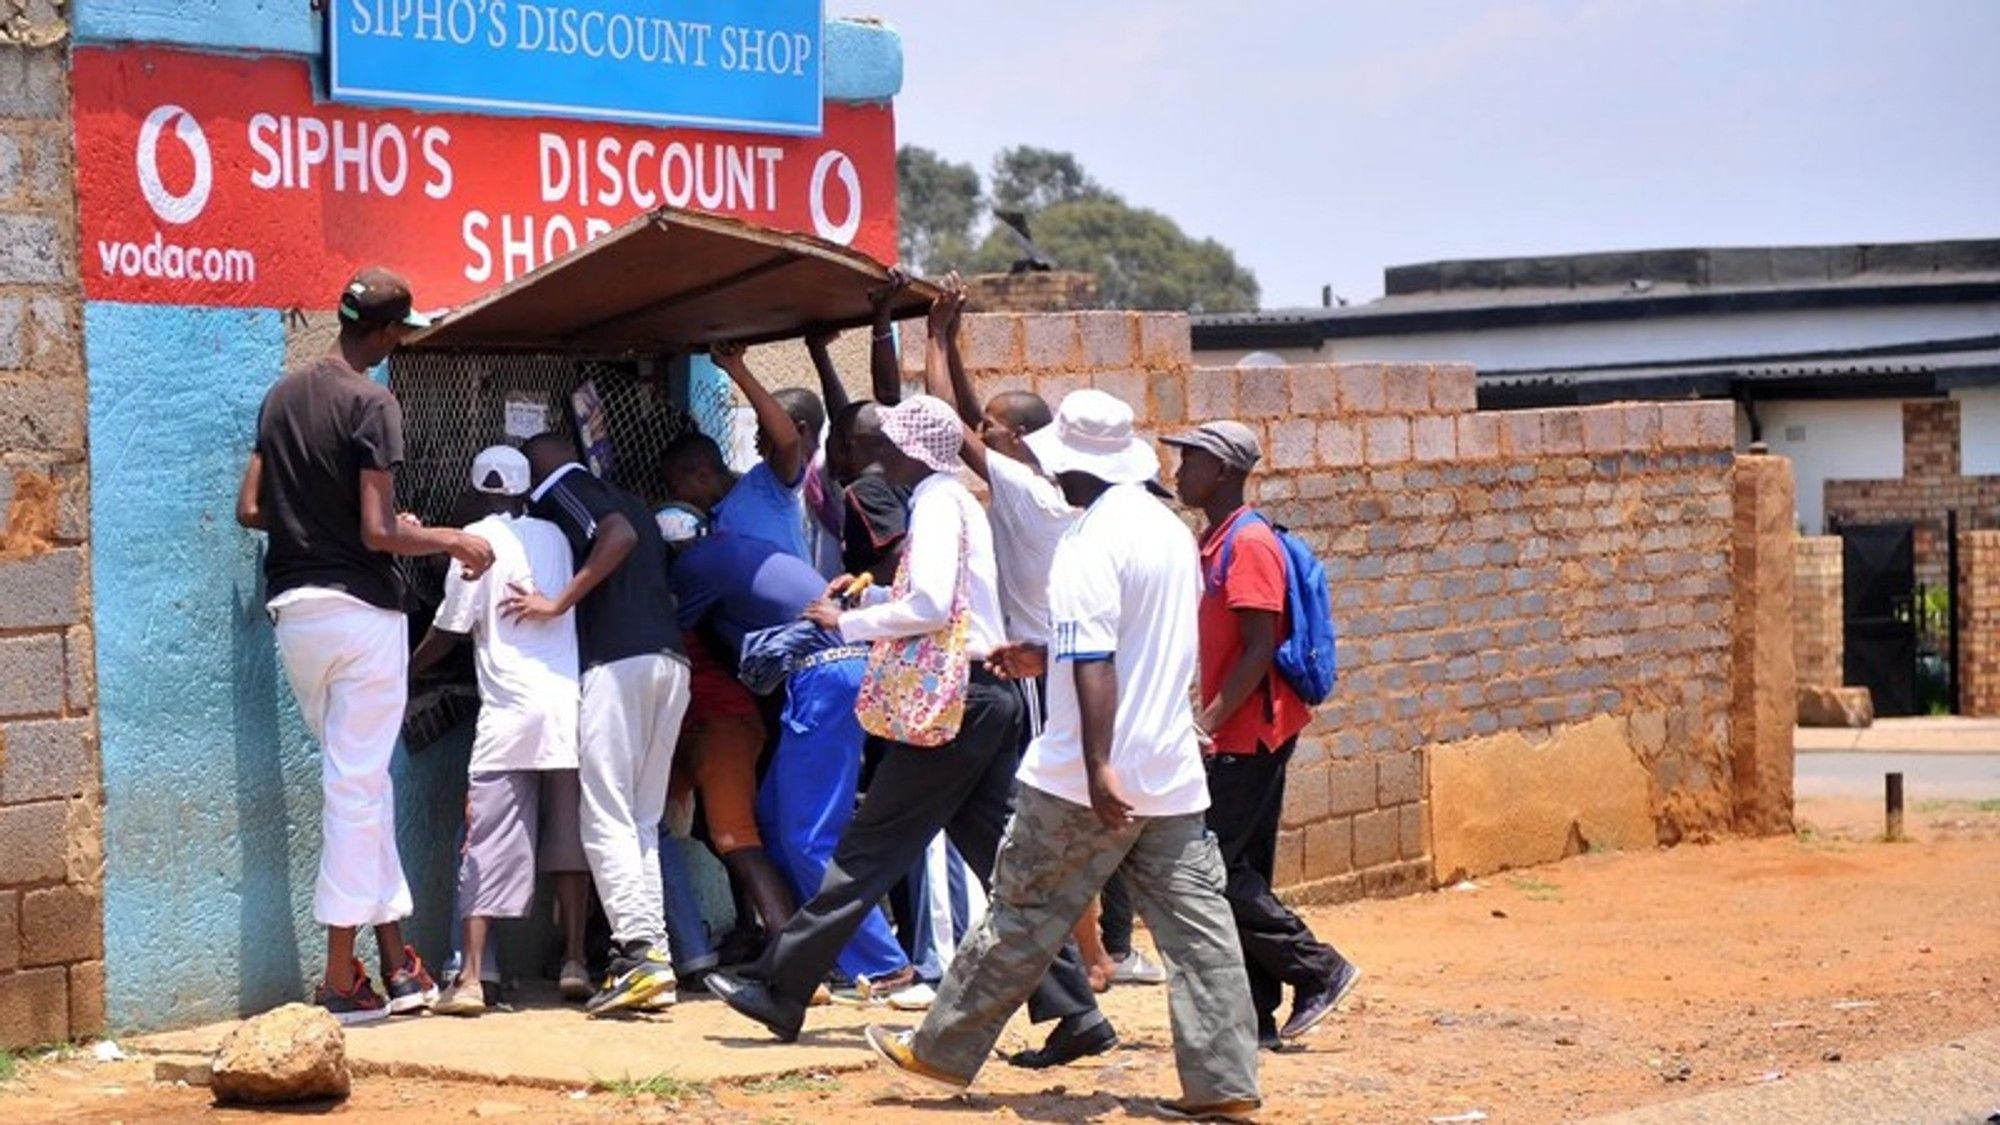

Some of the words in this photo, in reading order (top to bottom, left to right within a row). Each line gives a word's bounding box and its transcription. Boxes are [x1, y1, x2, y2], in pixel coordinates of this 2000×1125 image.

[351, 0, 508, 48] SIPHO'S
[516, 4, 712, 68] DISCOUNT
[721, 27, 812, 77] SHOP
[247, 113, 454, 200] SIPHO'S
[539, 132, 784, 212] DISCOUNT
[98, 232, 256, 283] vodacom
